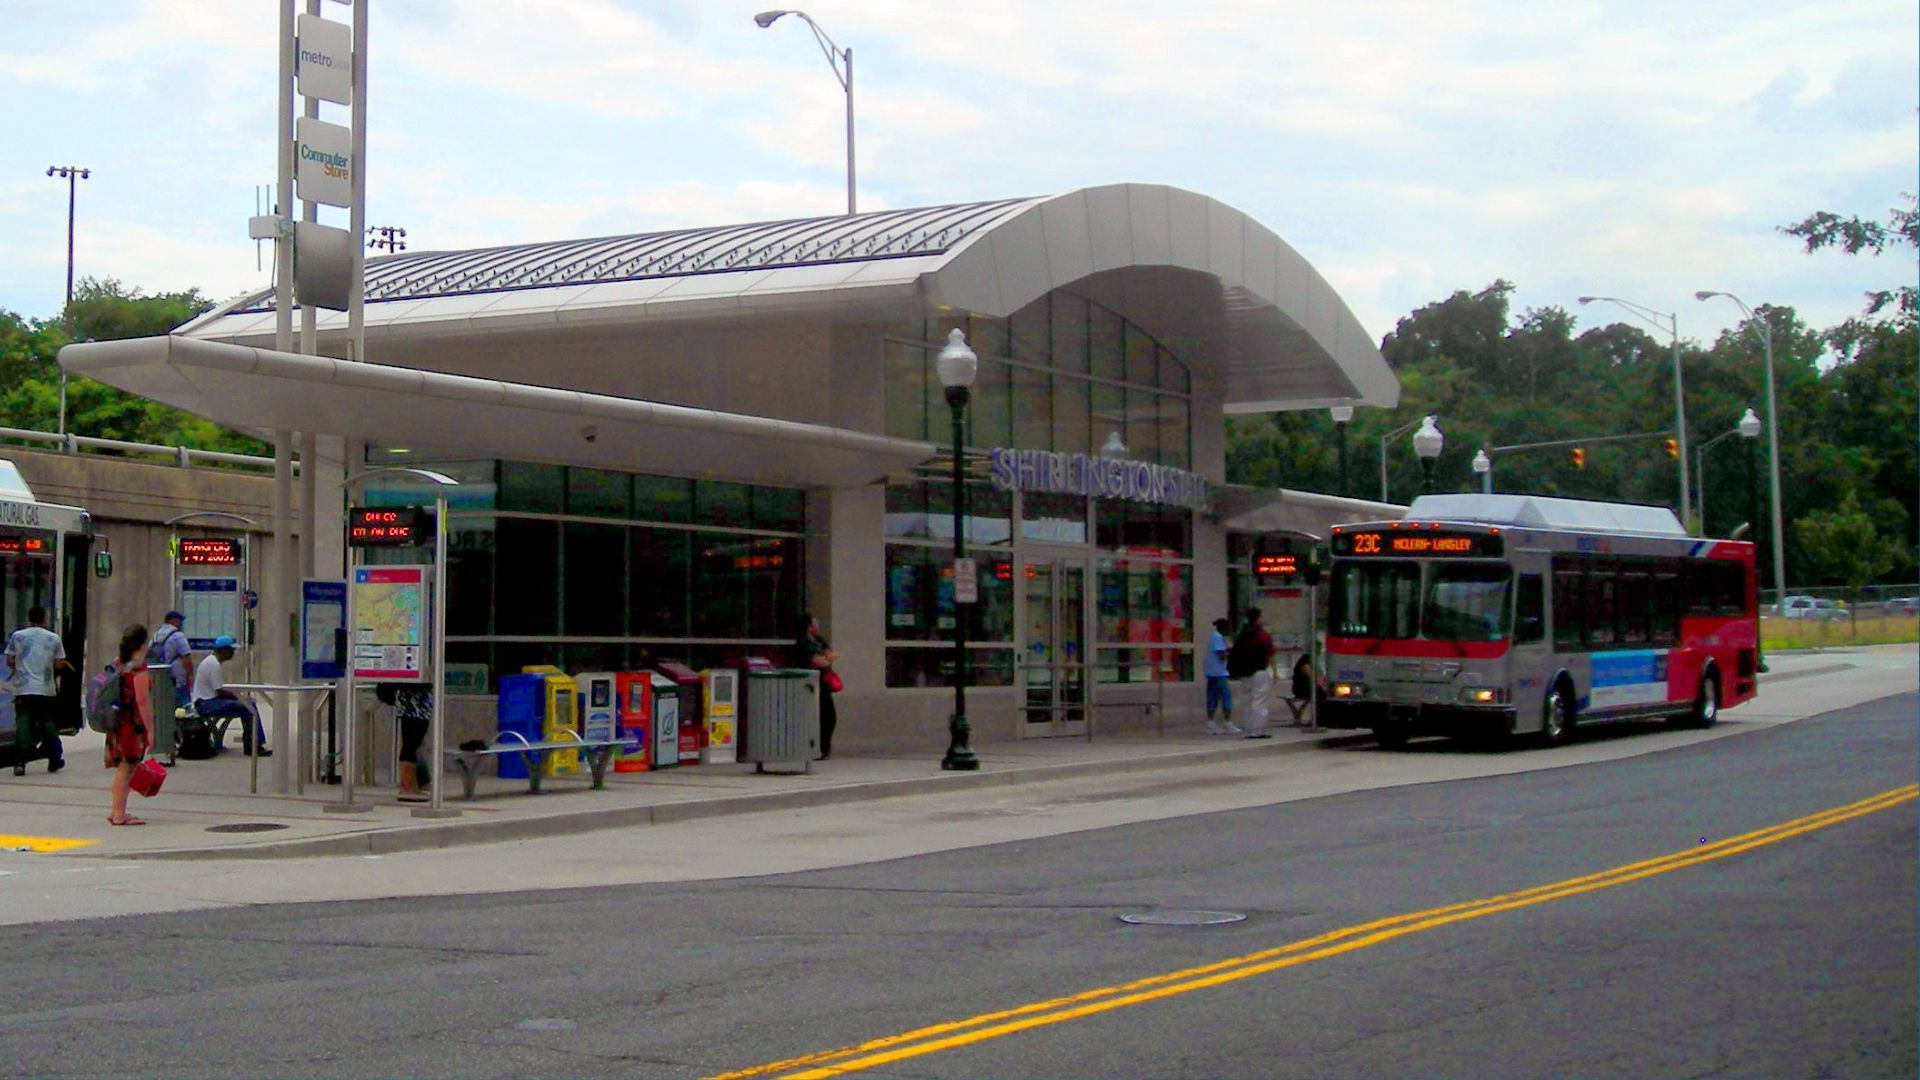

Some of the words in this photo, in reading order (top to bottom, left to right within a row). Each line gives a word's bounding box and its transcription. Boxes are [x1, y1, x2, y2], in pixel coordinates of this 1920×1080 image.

[301, 144, 348, 167] Commuter
[324, 163, 348, 180] Store
[992, 447, 1168, 503] SHIRLINGTON
[26, 505, 40, 525] GAS
[1354, 534, 1381, 553] 23C
